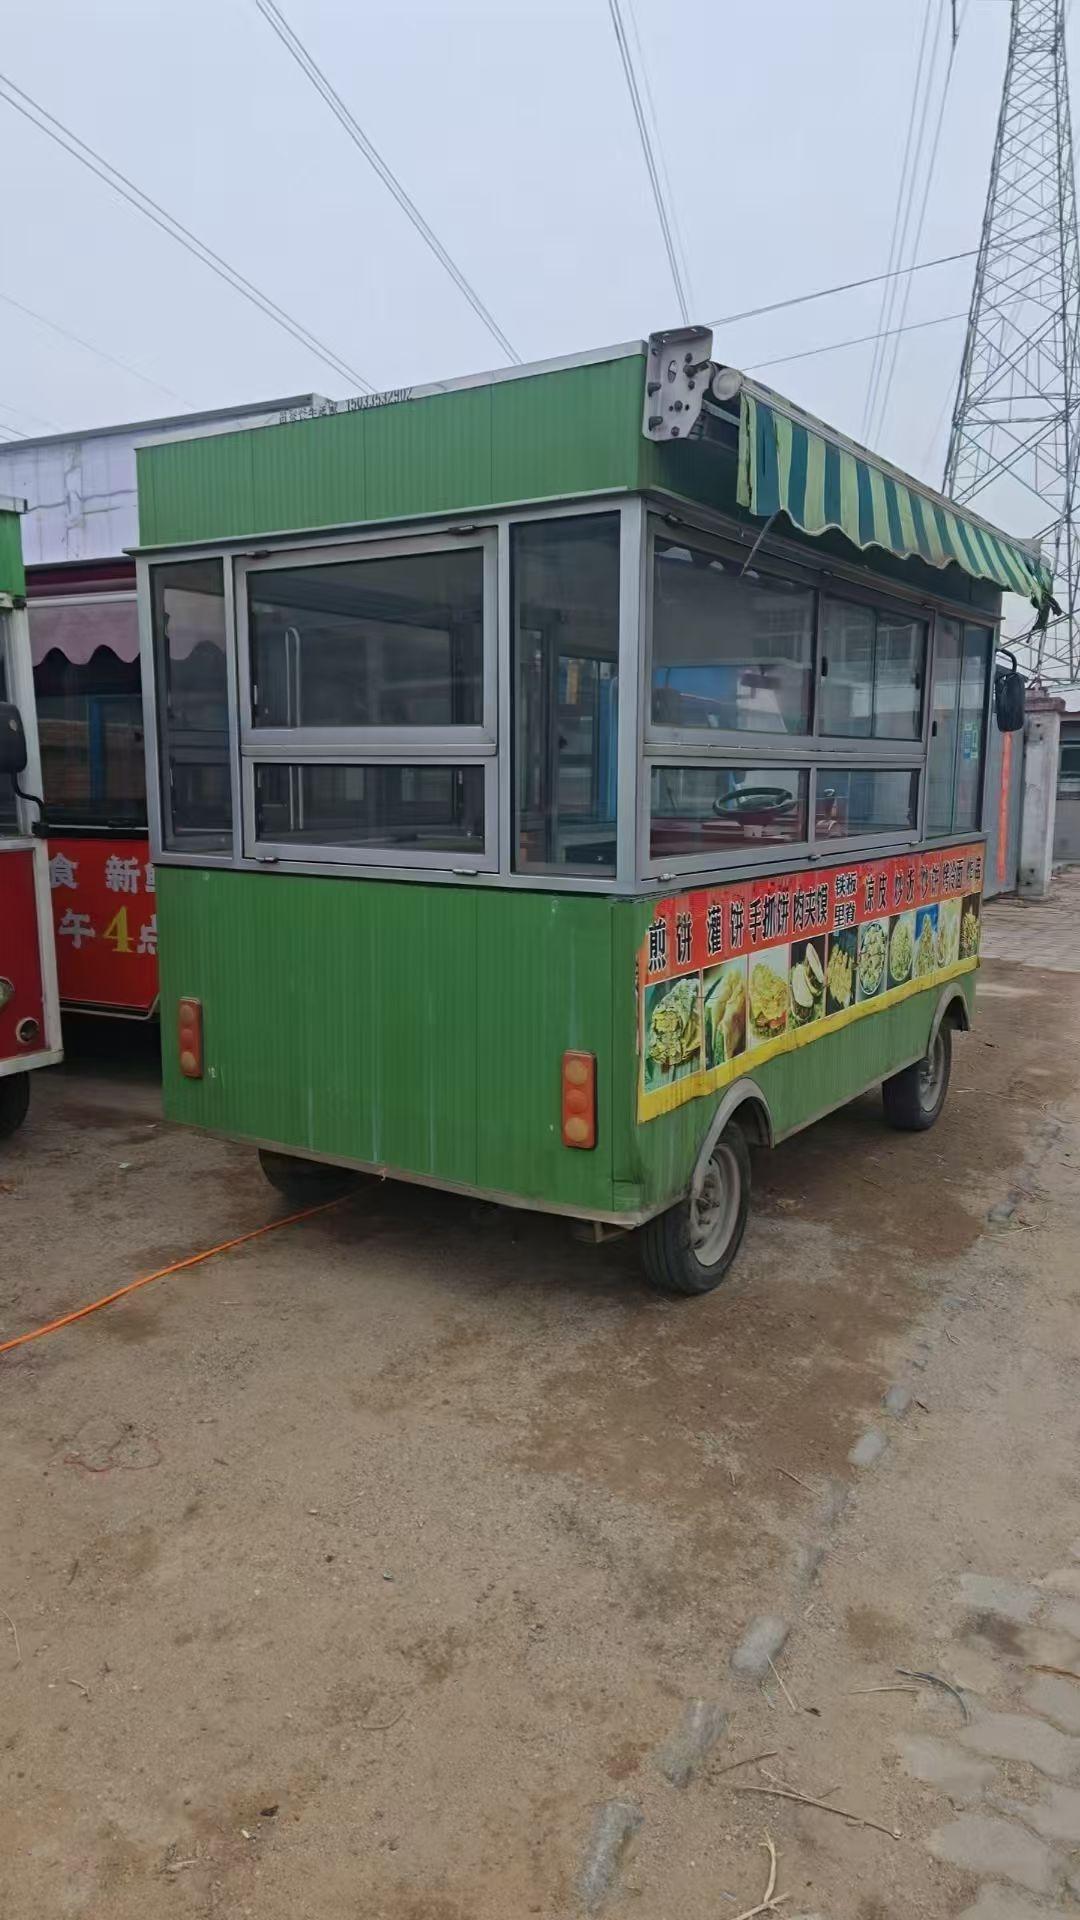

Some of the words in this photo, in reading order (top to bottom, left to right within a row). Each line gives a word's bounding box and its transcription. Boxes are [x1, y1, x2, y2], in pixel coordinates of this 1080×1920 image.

[834, 872, 858, 898] 铁板
[864, 870, 888, 914] 凉皮
[648, 912, 693, 973] 煎饼
[706, 900, 744, 956] 灌饼
[749, 891, 790, 944] 手抓饼
[792, 883, 829, 934] 肉夹馍
[833, 901, 857, 930] 里脊
